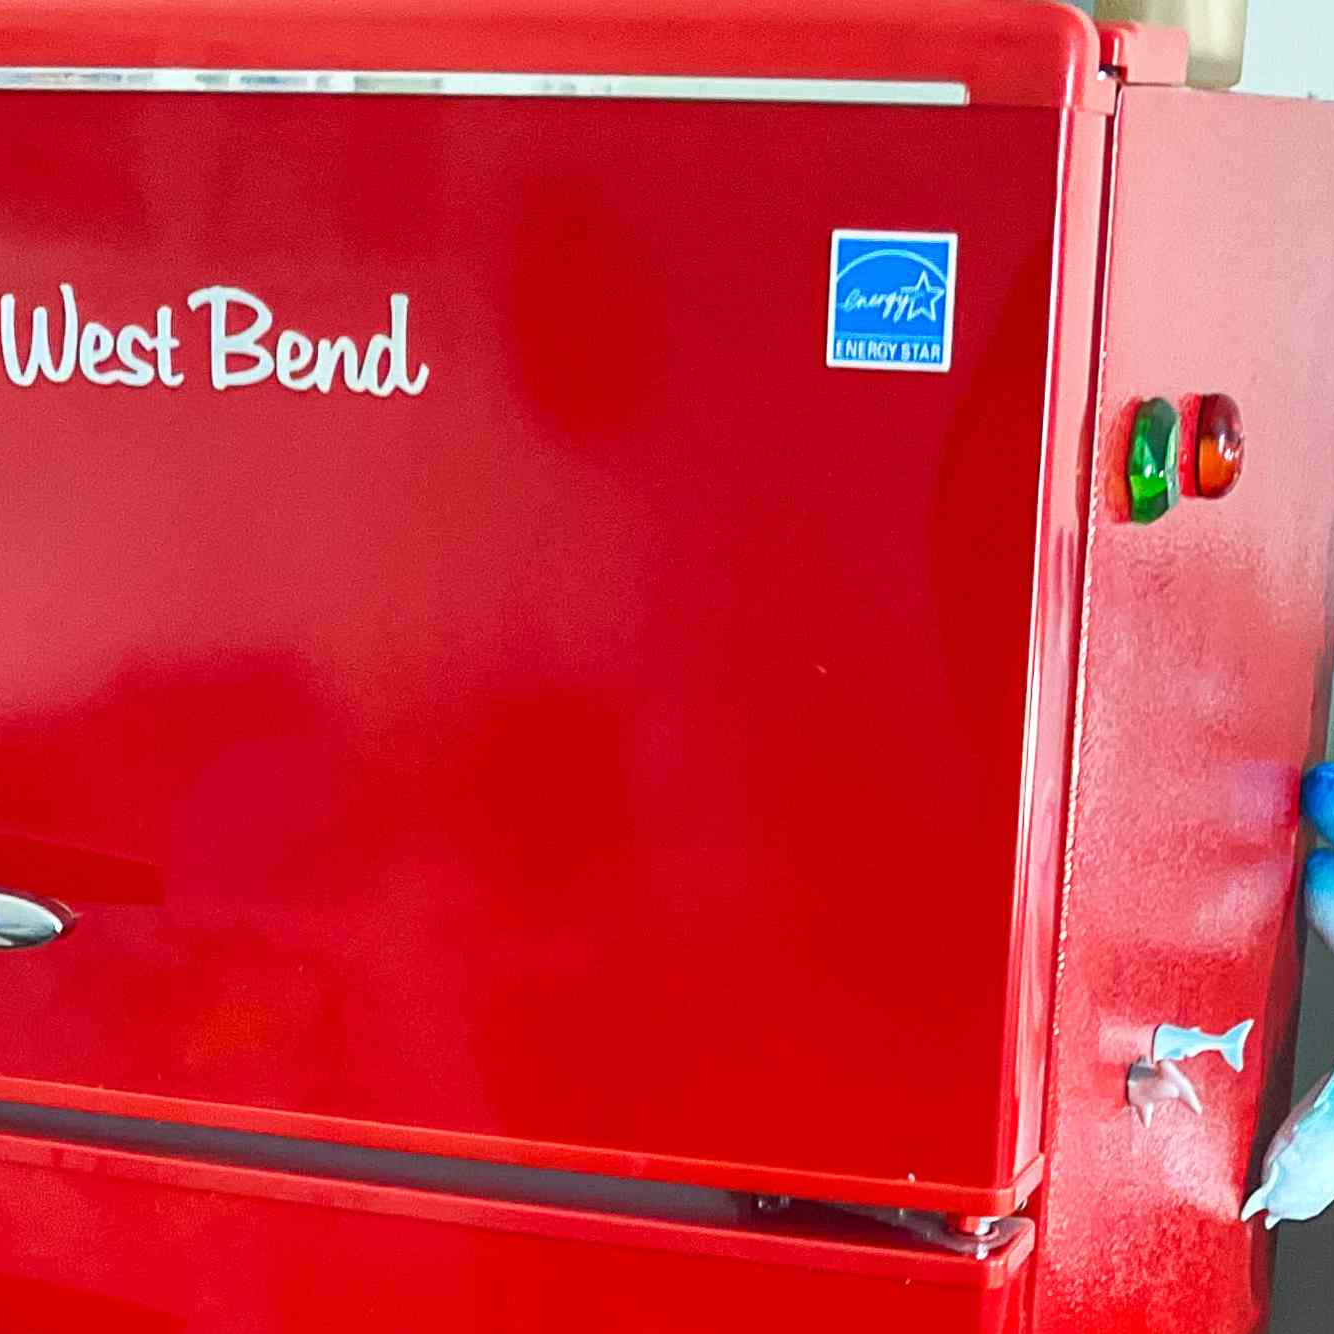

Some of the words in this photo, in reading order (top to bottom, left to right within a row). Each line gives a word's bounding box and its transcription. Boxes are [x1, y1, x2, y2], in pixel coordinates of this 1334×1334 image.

[0, 283, 184, 387] West
[187, 285, 430, 397] Bend
[835, 338, 897, 360] ENERGY
[901, 341, 941, 362] STAR
